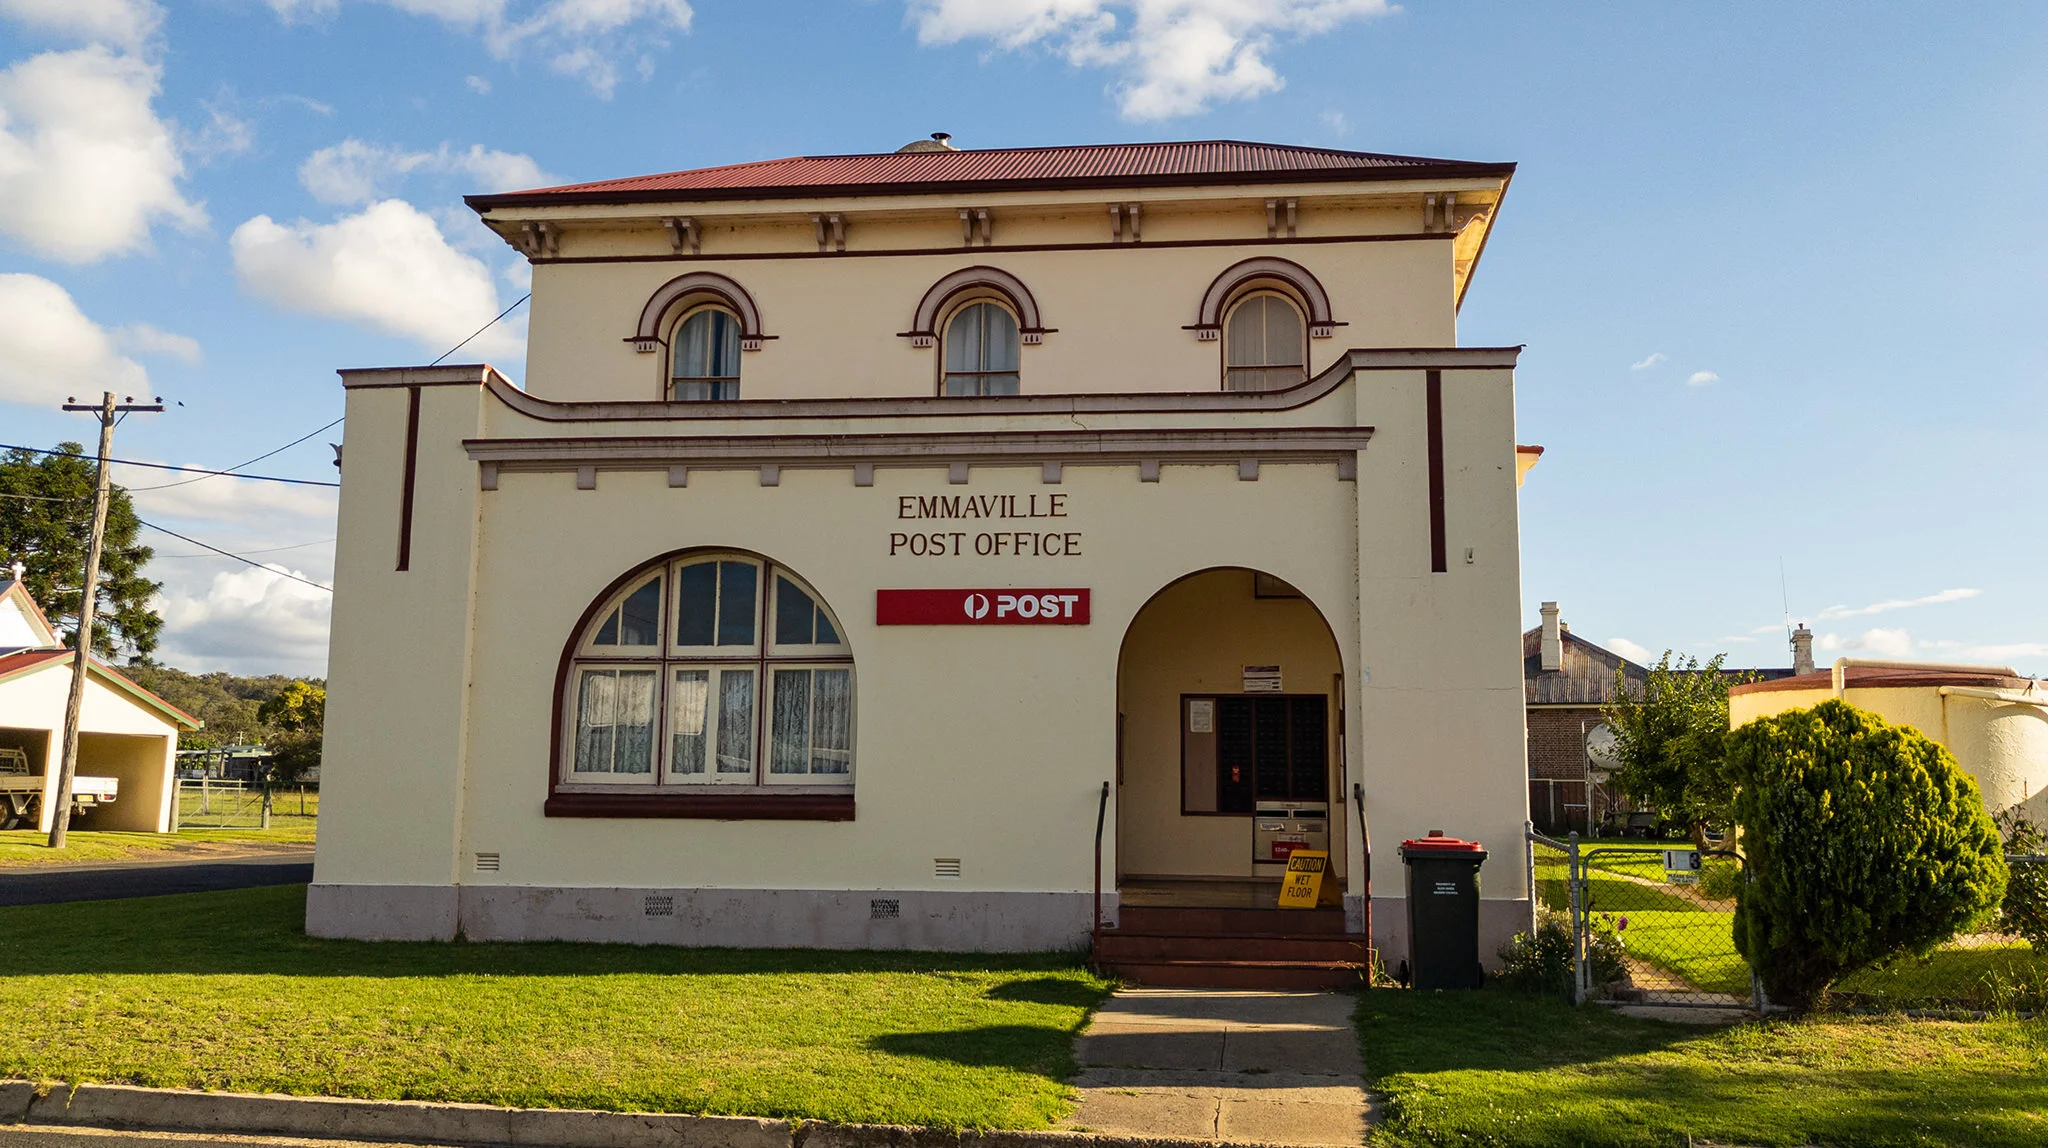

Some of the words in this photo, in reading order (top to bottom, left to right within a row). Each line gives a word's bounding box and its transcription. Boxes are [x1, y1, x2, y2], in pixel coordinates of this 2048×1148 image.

[898, 493, 1068, 519] EMMAVILLE
[889, 532, 966, 557] POST
[974, 532, 1082, 557] OFFICE
[997, 594, 1079, 618] POST
[1290, 857, 1323, 872] CAUTION
[1690, 852, 1701, 869] 3
[1295, 874, 1312, 885] WET
[1287, 886, 1313, 898] FLOOR
